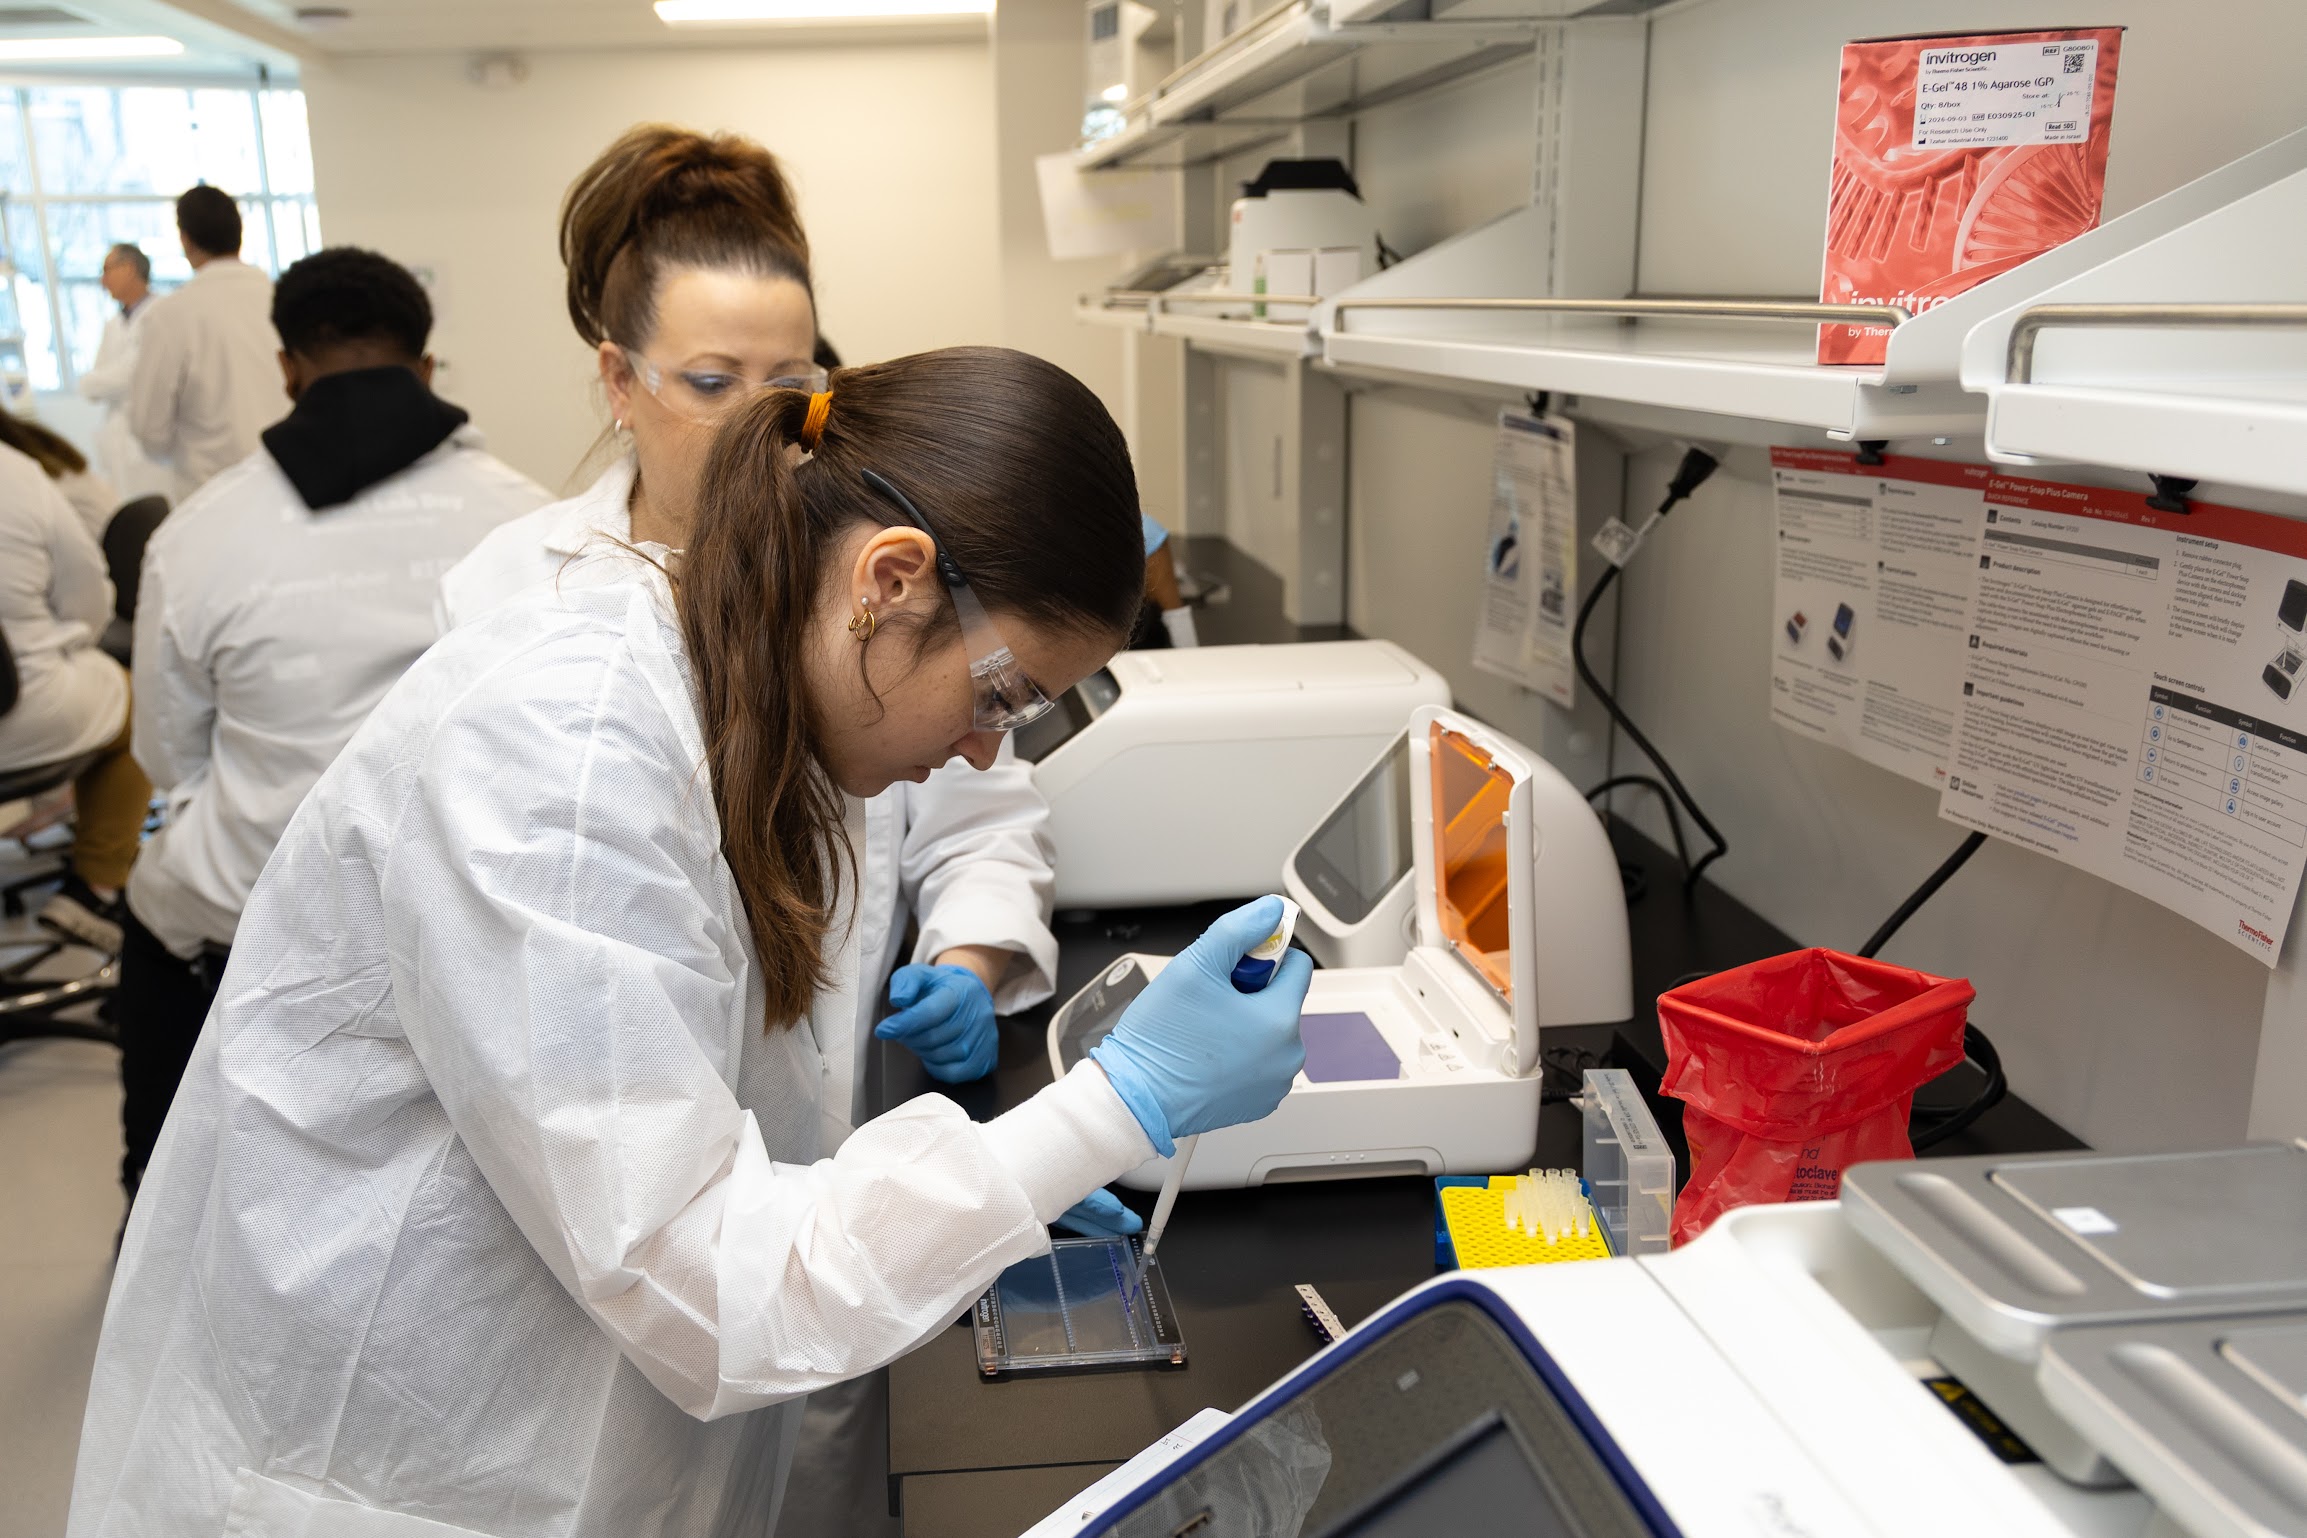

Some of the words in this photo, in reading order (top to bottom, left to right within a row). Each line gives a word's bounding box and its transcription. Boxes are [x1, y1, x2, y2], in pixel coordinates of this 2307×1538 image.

[1926, 52, 1996, 65] invitrogen
[1972, 81, 1988, 90] 1%
[1990, 80, 2031, 91] Agarose
[2034, 77, 2054, 87] (GP)
[1921, 102, 1936, 110] Qty:
[1848, 328, 1861, 338] by
[2009, 482, 2028, 492] Power
[2029, 484, 2045, 495] Snap
[2046, 487, 2061, 496] Plus
[2061, 489, 2088, 500] Camera
[1999, 514, 2021, 524] Contents
[2176, 535, 2204, 546] Instrument
[2204, 541, 2218, 550] setup
[2181, 551, 2198, 559] Remove
[1993, 560, 2012, 570] Product
[2012, 564, 2040, 576] description
[2187, 572, 2204, 580] Camera
[1982, 640, 2004, 651] Required
[2004, 646, 2027, 657] materials
[2153, 672, 2167, 681] Touch
[2168, 677, 2184, 687] screen
[2184, 682, 2205, 693] controls
[1976, 688, 1998, 700] Important
[1999, 695, 2024, 708] guidelines
[2176, 738, 2191, 748] Settings
[2279, 733, 2297, 743] Function
[2254, 743, 2269, 752] Capture
[2269, 749, 2280, 757] image
[2163, 756, 2175, 764] Return
[2180, 763, 2195, 772] previous
[2246, 788, 2259, 797] Access
[2259, 793, 2270, 802] image
[2270, 798, 2283, 808] gallery
[2266, 819, 2280, 828] account
[2239, 920, 2273, 946] ThermoFisher
[2238, 930, 2271, 952] SCIENTIFIC
[1801, 1147, 1820, 1160] nd
[1796, 1166, 1837, 1180] toclave
[980, 1298, 990, 1322] invitrogen
